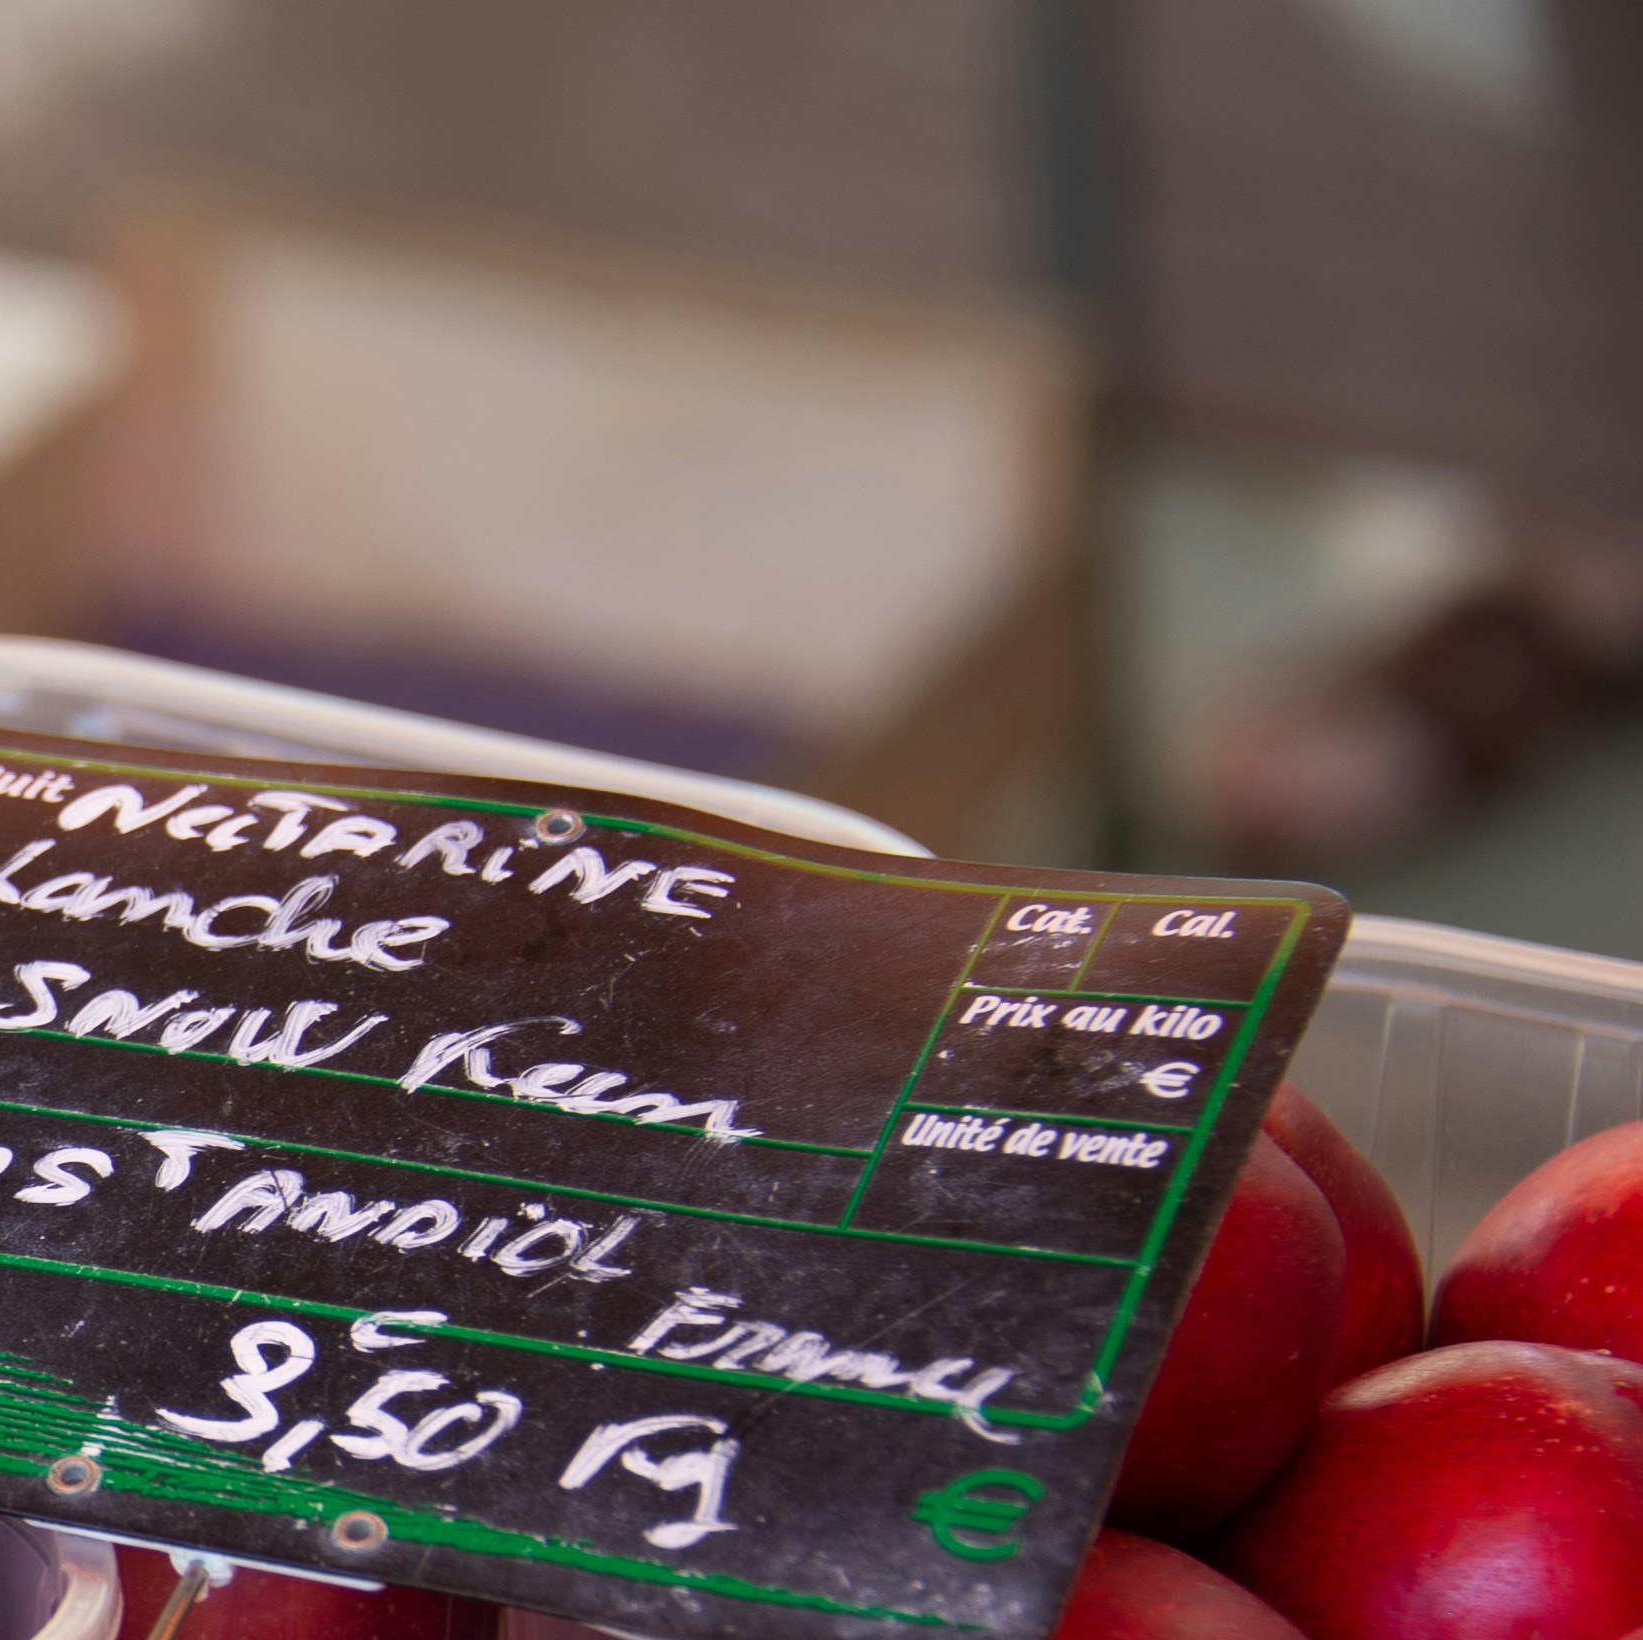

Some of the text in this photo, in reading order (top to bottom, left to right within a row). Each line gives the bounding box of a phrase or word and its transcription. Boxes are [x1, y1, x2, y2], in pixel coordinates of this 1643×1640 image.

[1006, 903, 1093, 935] Cat.
[1152, 909, 1236, 939] Cal.
[958, 993, 1224, 1041] Prix au kilo
[1139, 1061, 1202, 1099] €
[901, 1113, 1170, 1169] Unité de vente
[911, 1467, 1046, 1562] €
